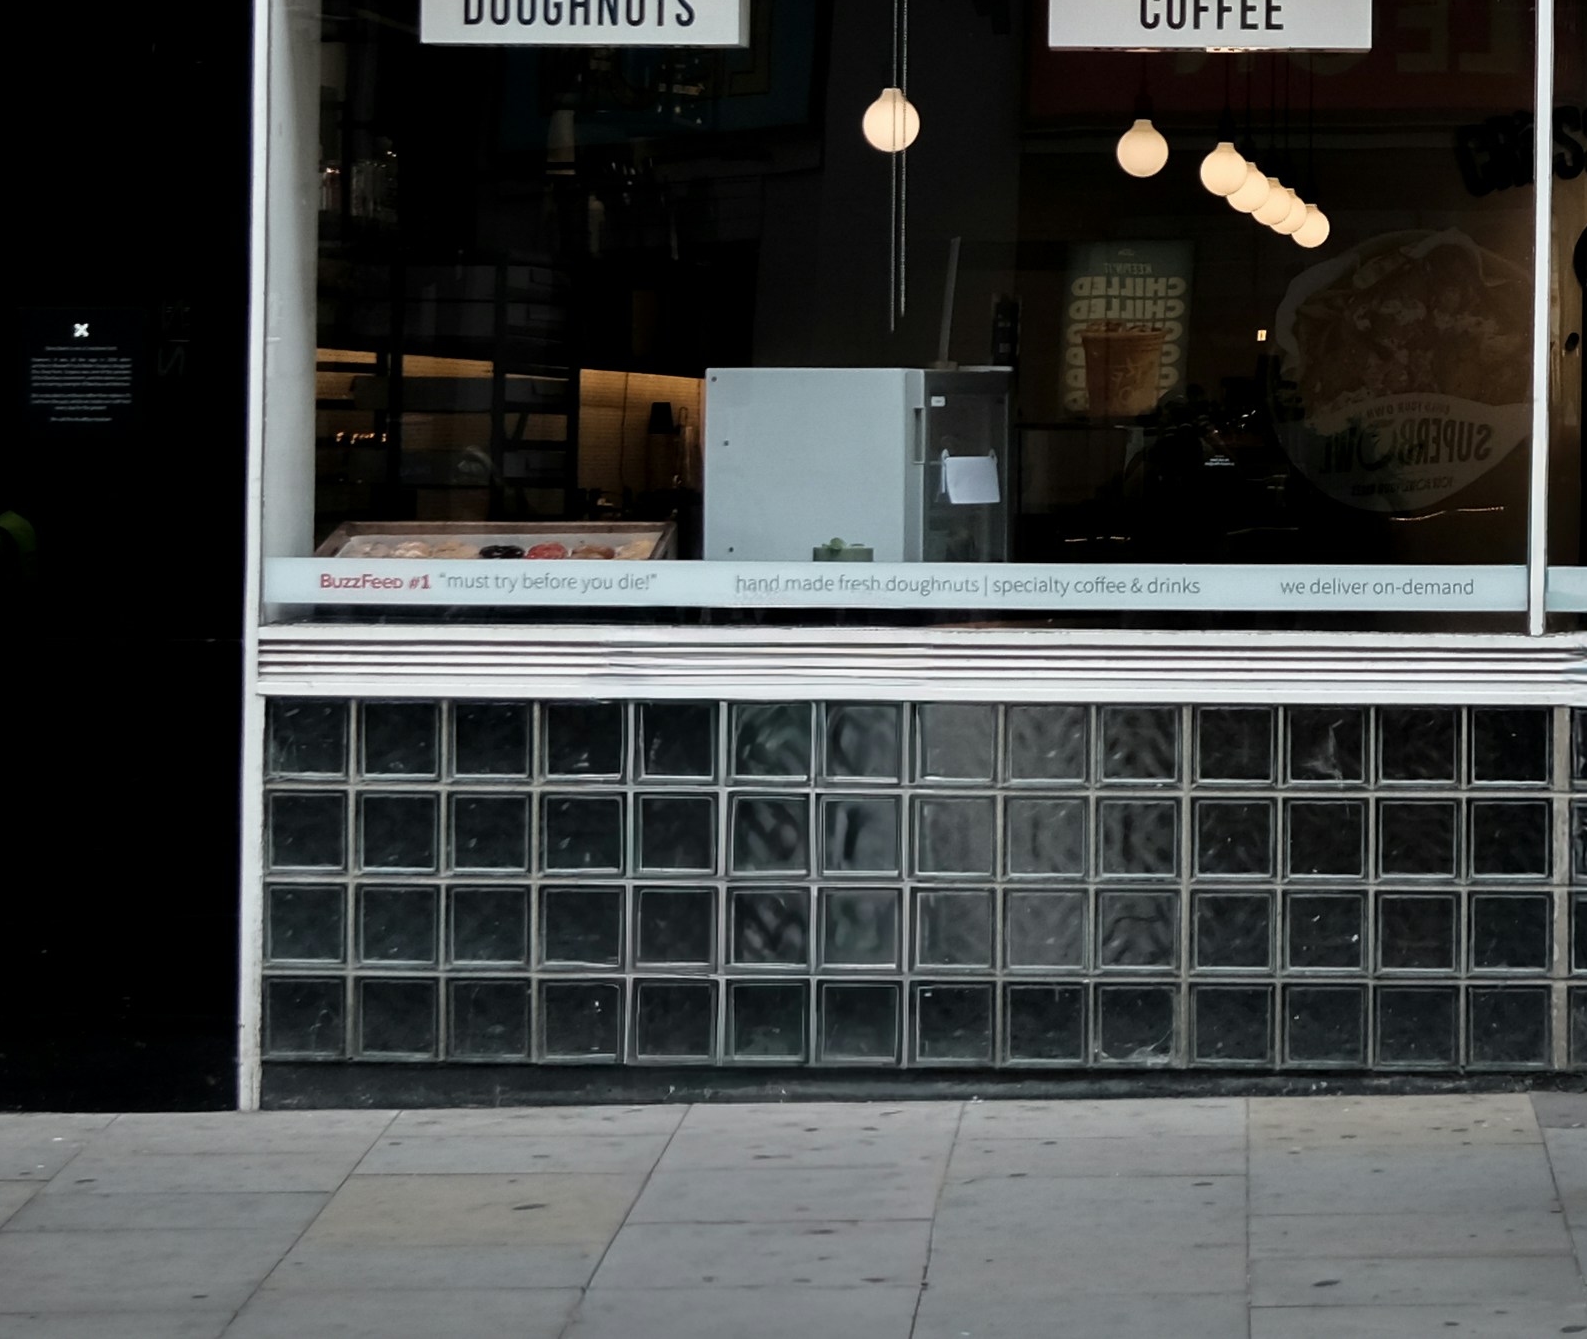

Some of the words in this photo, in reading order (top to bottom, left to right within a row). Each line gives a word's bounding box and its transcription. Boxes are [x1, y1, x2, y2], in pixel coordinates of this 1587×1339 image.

[409, 573, 431, 590] #1
[494, 574, 517, 594] try
[523, 572, 578, 590] before
[581, 576, 612, 595] you
[735, 574, 779, 593] hand
[785, 574, 834, 593] made
[838, 574, 880, 593] fresh
[886, 574, 979, 597] doughnuts
[993, 575, 1069, 598] specialty
[1074, 575, 1126, 594] coffee
[1131, 577, 1144, 594] &
[1147, 576, 1200, 595] drinks
[1280, 580, 1306, 595] we
[1310, 577, 1368, 595] deliver
[1373, 578, 1474, 596] on-demand
